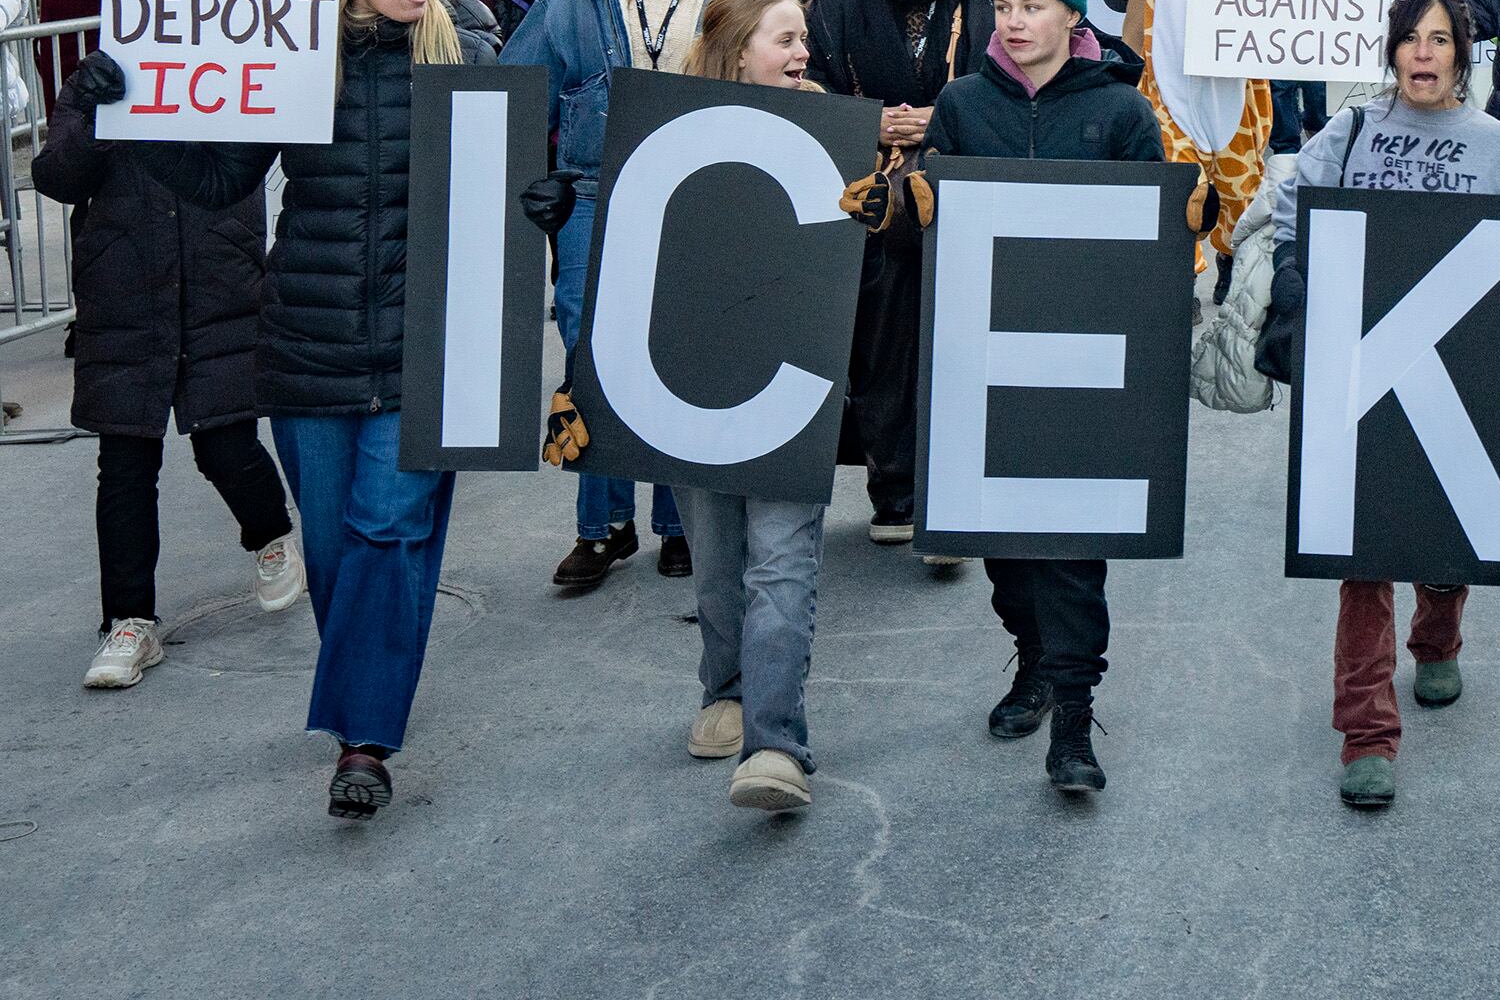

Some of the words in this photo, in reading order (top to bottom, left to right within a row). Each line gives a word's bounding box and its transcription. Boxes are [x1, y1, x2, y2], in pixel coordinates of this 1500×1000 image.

[1215, 28, 1385, 68] FASCISM
[129, 62, 277, 115] ICE
[1370, 133, 1420, 157] HEY
[1424, 137, 1467, 163] ICE
[1384, 156, 1413, 169] GET
[1417, 161, 1446, 174] THE
